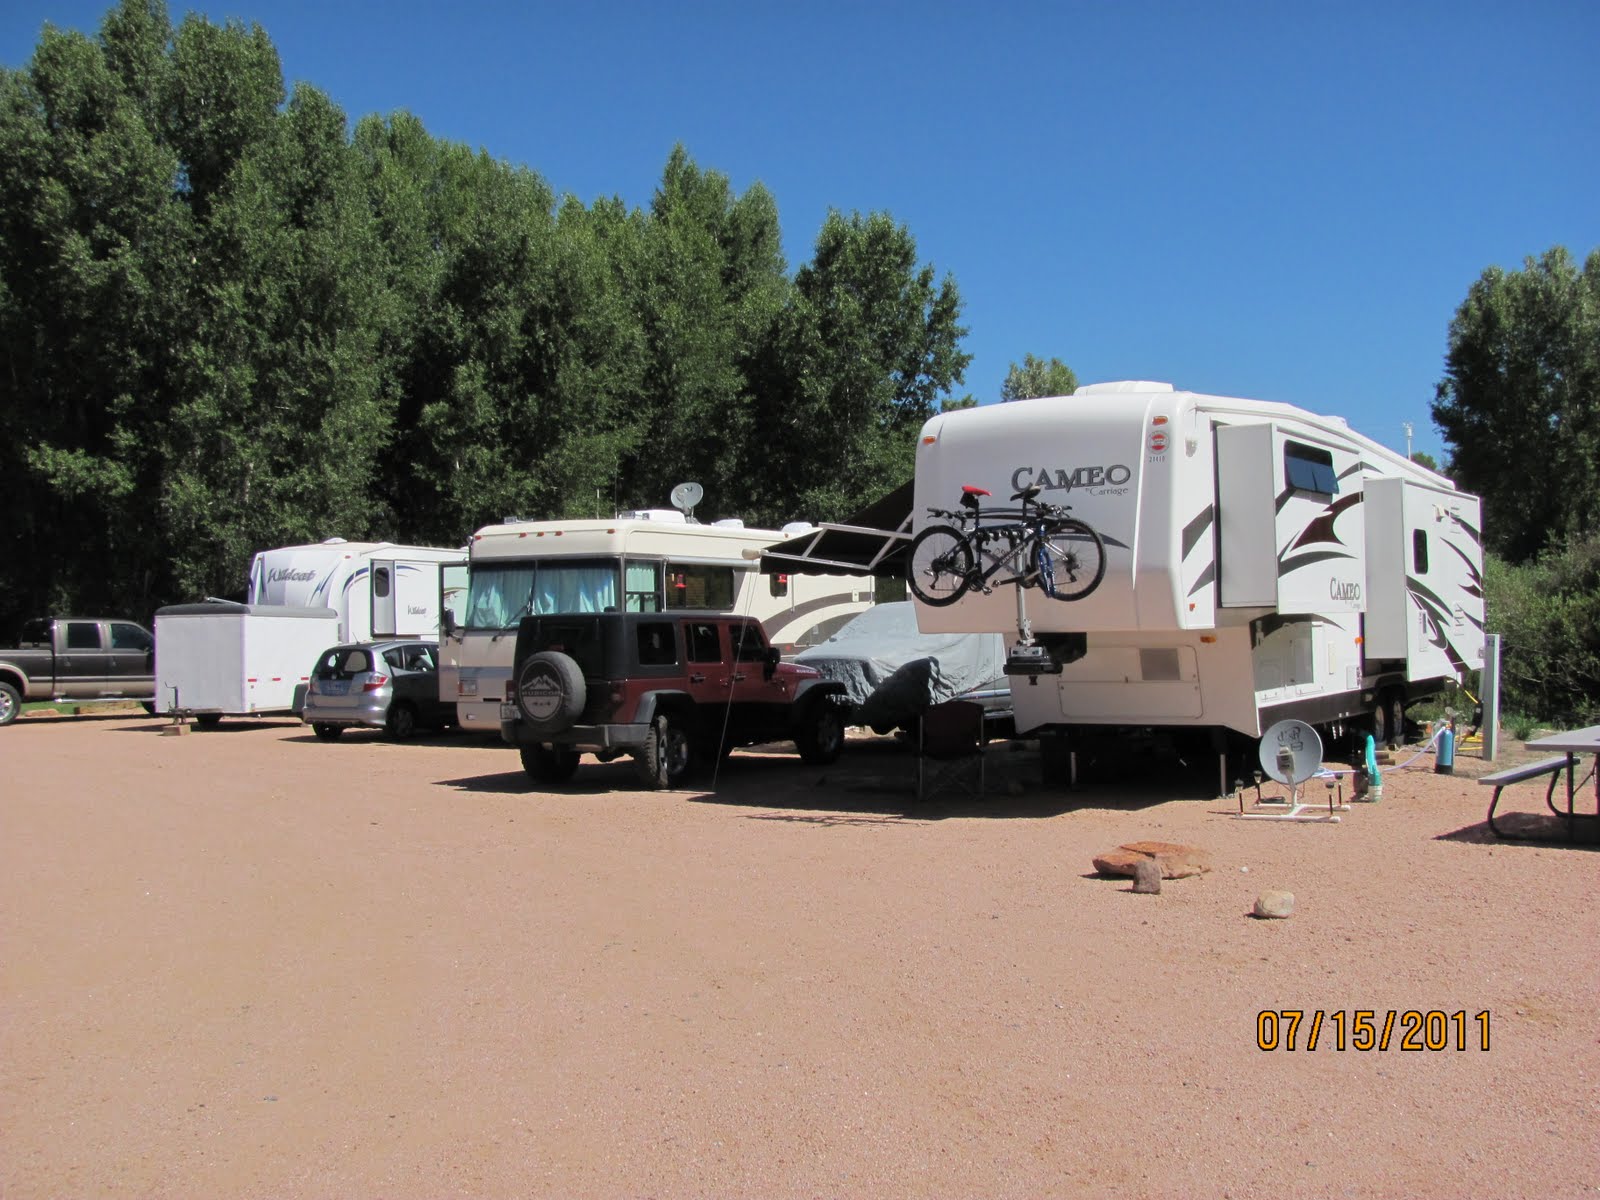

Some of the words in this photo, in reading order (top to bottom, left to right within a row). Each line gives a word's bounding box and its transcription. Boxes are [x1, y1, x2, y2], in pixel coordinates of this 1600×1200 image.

[1011, 464, 1131, 493] CAMEO
[1090, 487, 1128, 496] Carriage
[267, 567, 316, 584] Wildcat
[1329, 576, 1361, 604] CAMEO
